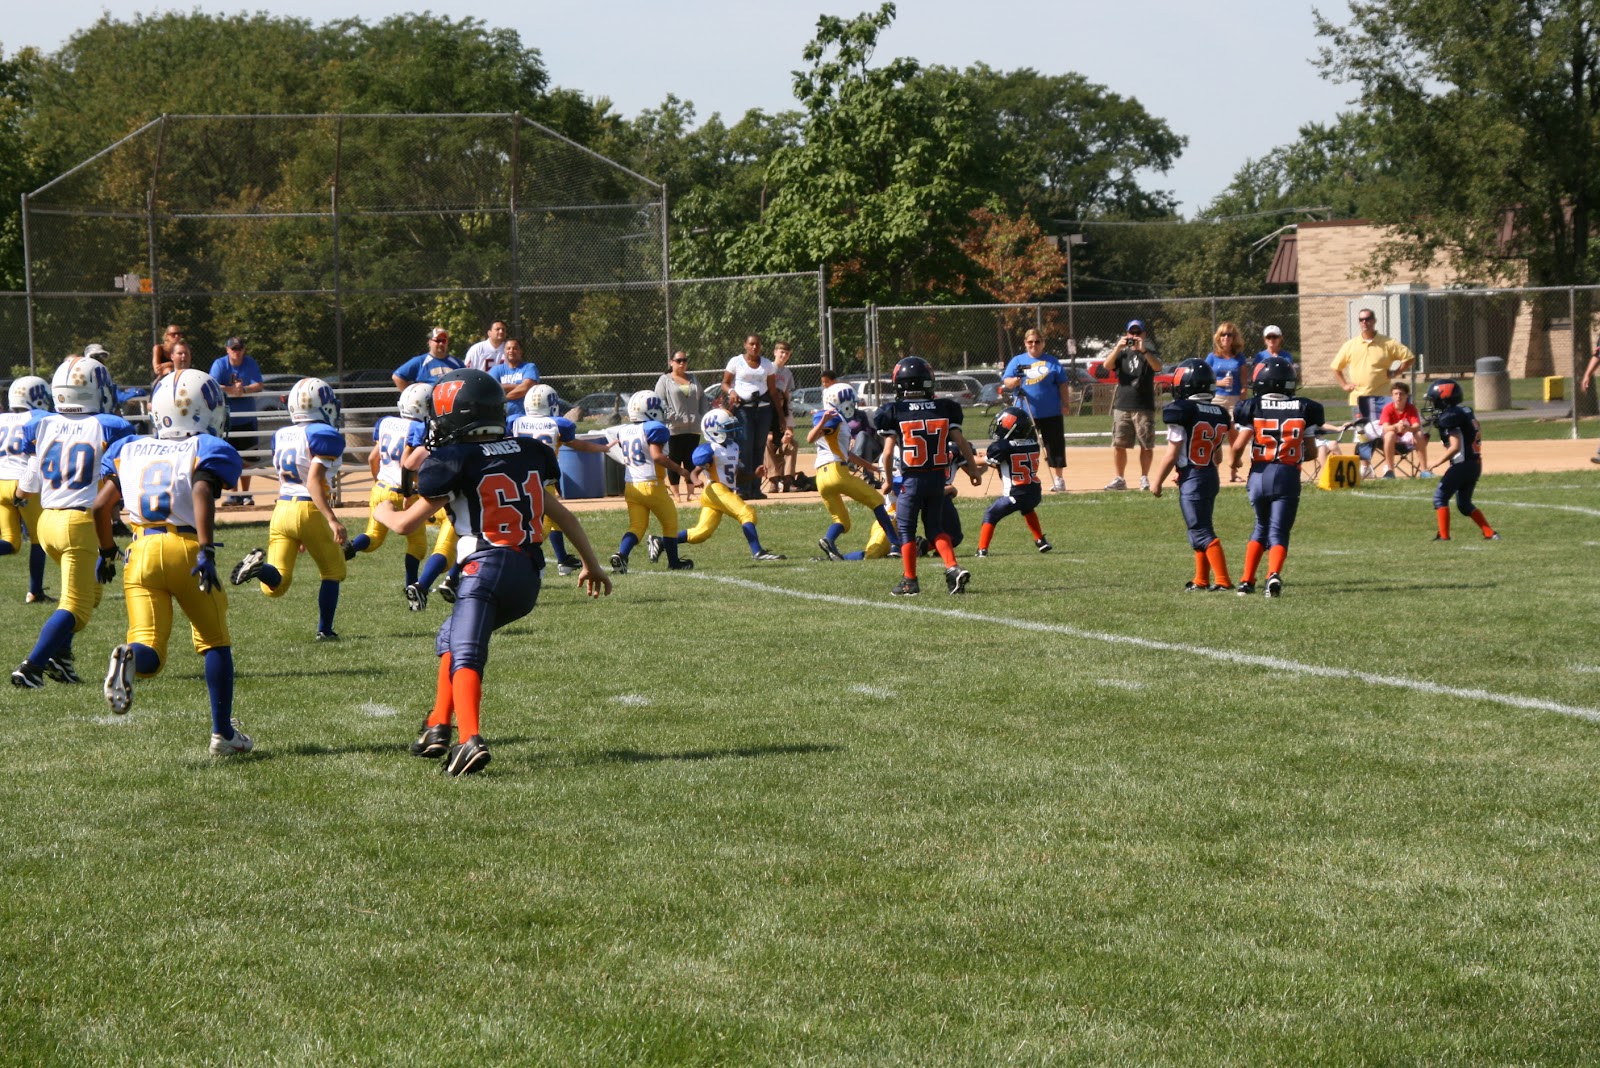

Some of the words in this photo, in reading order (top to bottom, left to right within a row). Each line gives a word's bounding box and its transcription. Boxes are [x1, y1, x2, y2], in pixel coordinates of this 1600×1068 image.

[432, 380, 465, 417] W
[908, 401, 937, 411] JOYCE
[1261, 400, 1299, 410] ELLISON
[55, 423, 83, 434] SMITH
[521, 422, 552, 430] NEWCOMB
[1251, 418, 1306, 464] 58
[479, 440, 521, 457] JONES
[899, 418, 949, 467] 57
[41, 440, 96, 490] 40
[1334, 460, 1357, 488] 40
[138, 459, 173, 523] 8
[476, 470, 545, 547] 61
